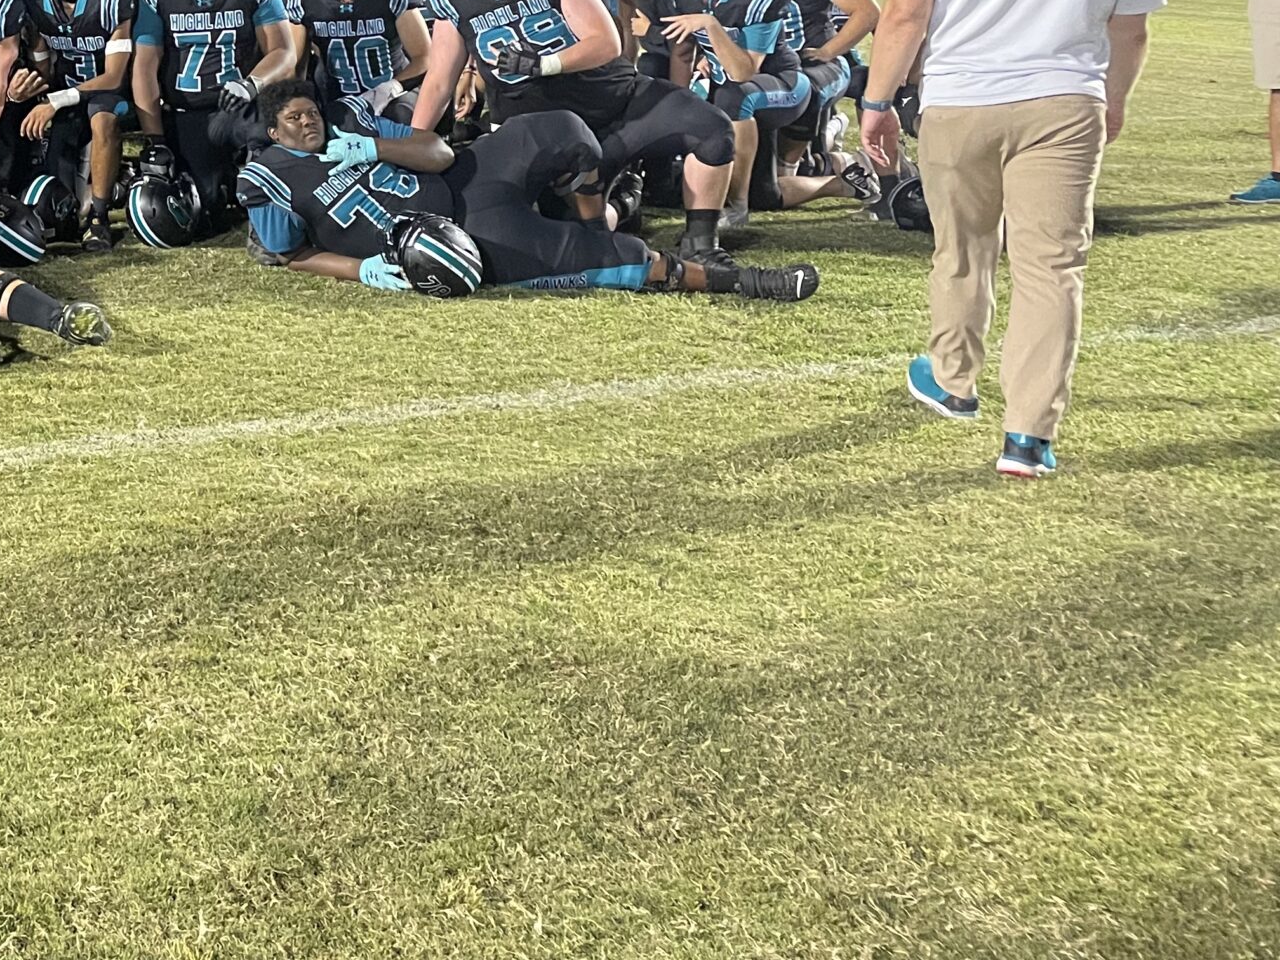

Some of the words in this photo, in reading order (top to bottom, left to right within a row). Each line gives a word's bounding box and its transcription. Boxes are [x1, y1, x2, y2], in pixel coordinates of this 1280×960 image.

[168, 8, 245, 32] HIGHLAND
[313, 17, 386, 38] HIGHLAND
[62, 50, 97, 89] 3
[172, 29, 244, 93] 71
[326, 35, 394, 95] 40
[312, 158, 371, 207] HIGHLA
[530, 273, 588, 291] HAWKS
